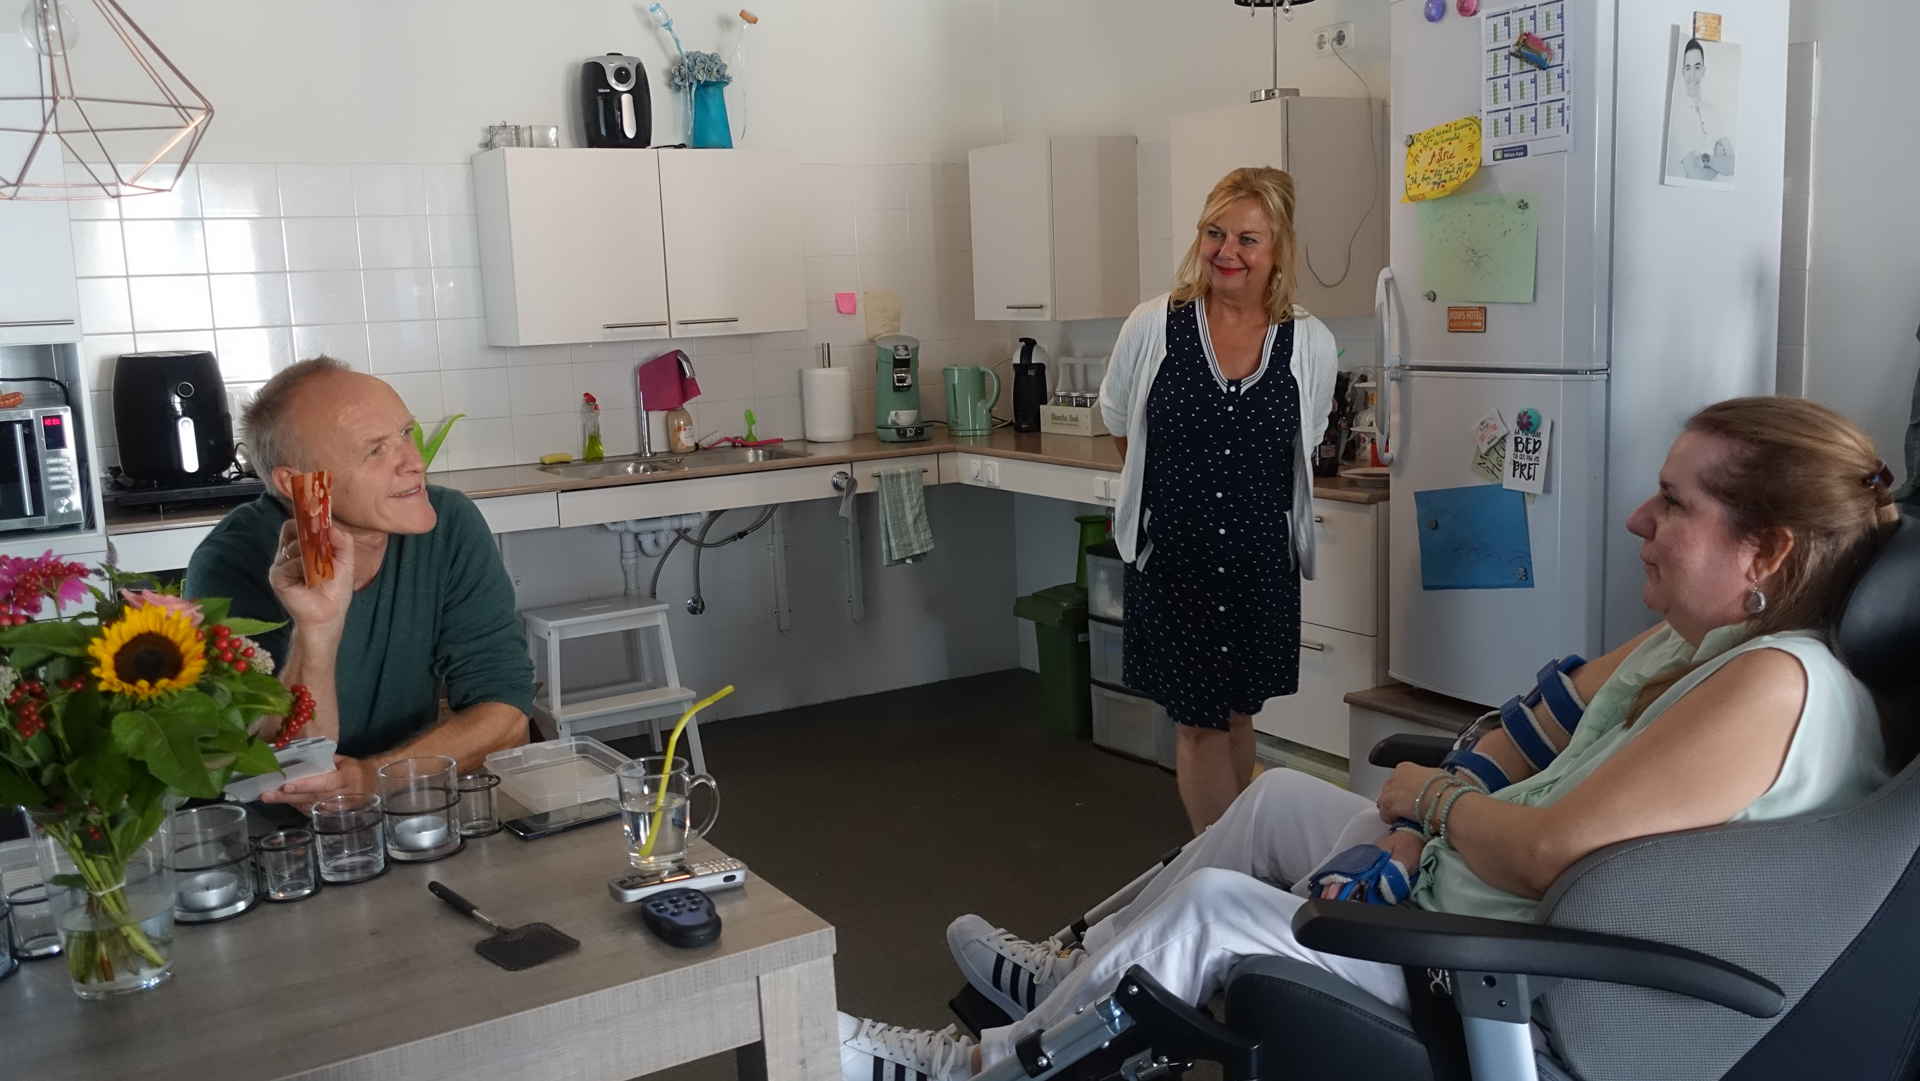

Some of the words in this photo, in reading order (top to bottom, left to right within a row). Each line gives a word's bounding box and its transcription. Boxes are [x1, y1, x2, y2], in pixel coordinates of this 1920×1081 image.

[1428, 146, 1456, 166] Astrid
[1466, 310, 1483, 320] HOTEL
[1513, 436, 1542, 455] BED
[1512, 459, 1540, 481] PRET
